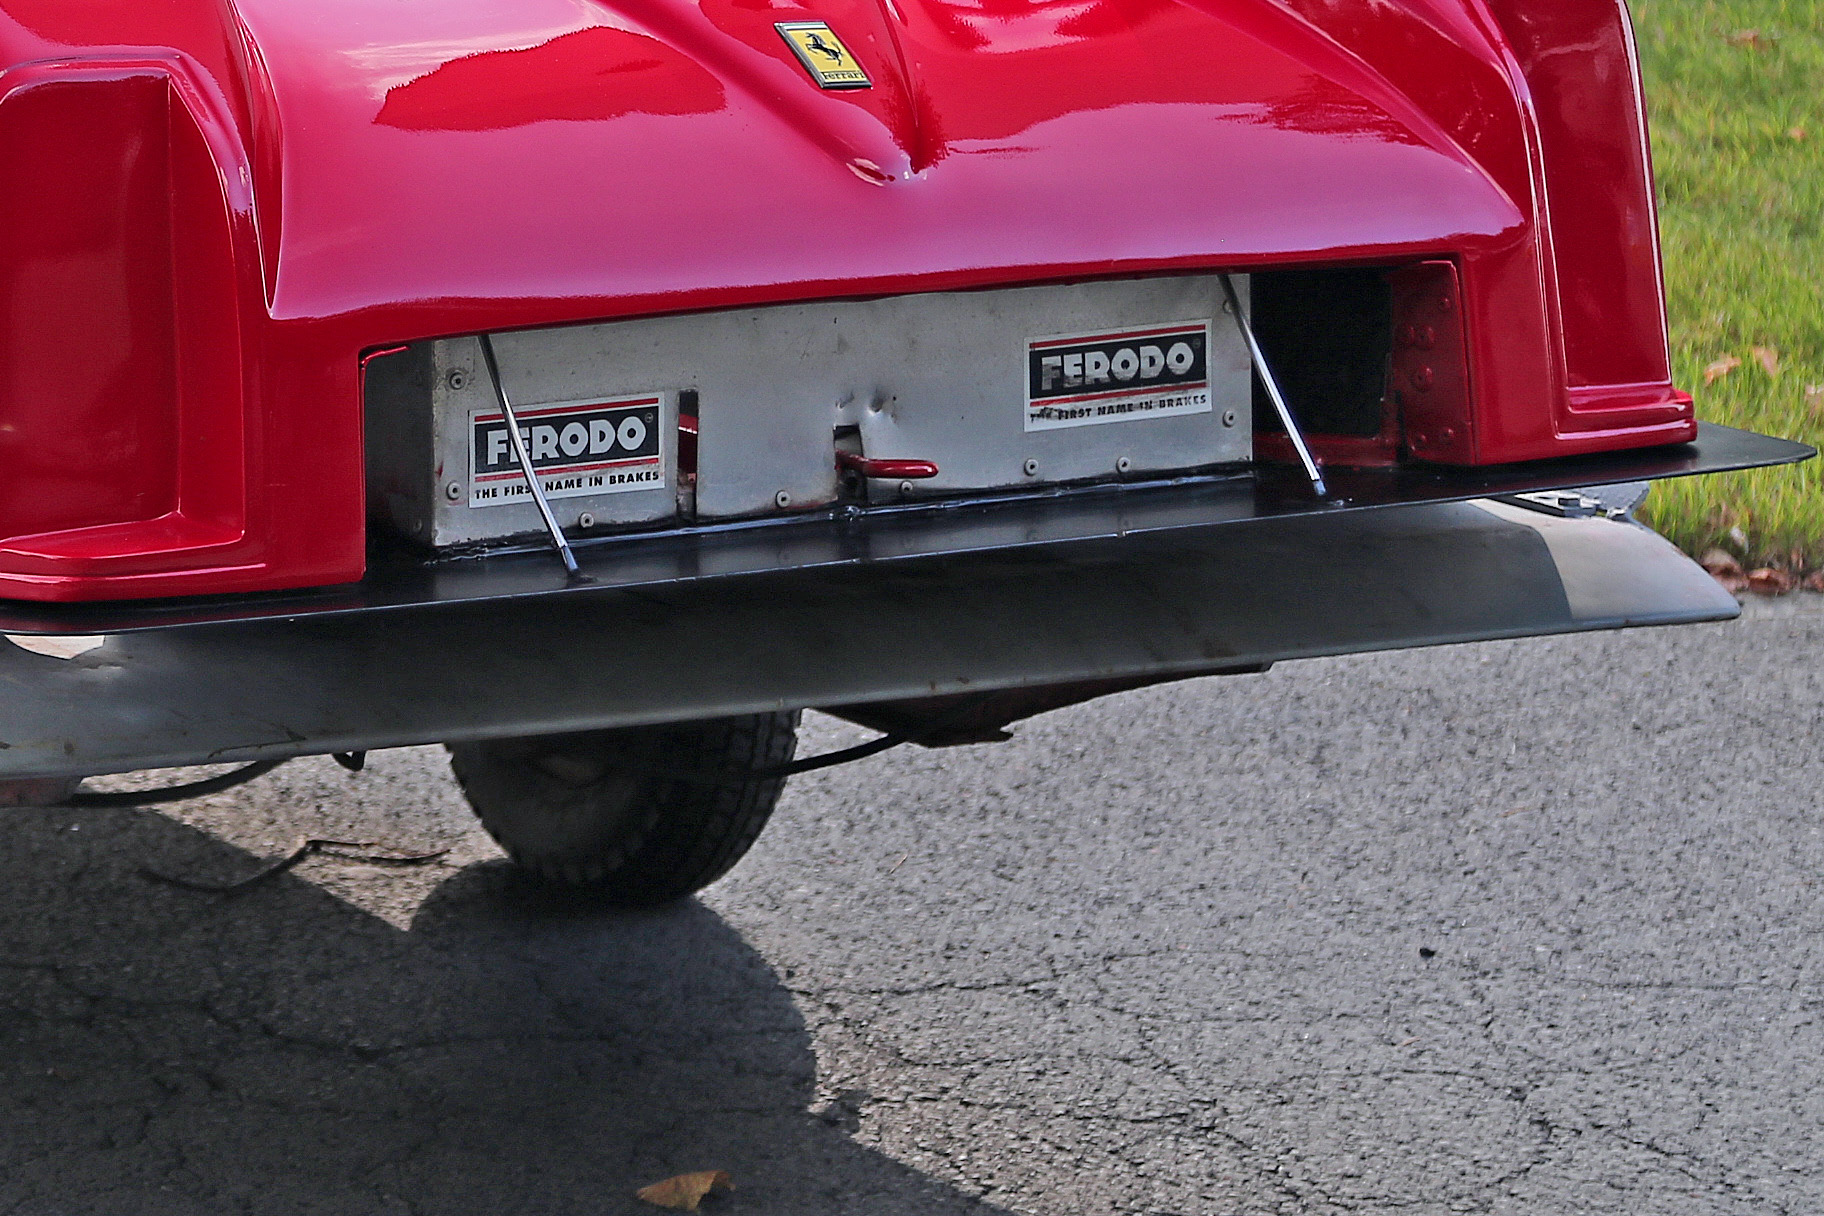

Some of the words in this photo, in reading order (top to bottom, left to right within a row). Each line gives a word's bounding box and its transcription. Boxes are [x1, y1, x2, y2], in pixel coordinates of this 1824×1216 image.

[1041, 342, 1194, 391] FERODO
[1057, 407, 1092, 420] FIRST
[1097, 403, 1134, 416] NAME
[1139, 400, 1153, 411] IN
[1159, 394, 1207, 409] BRAKES
[476, 487, 498, 499] THE
[504, 485, 532, 497] FIRS
[544, 478, 583, 492] NAME
[588, 476, 603, 487] IN
[609, 471, 660, 485] BRAKES
